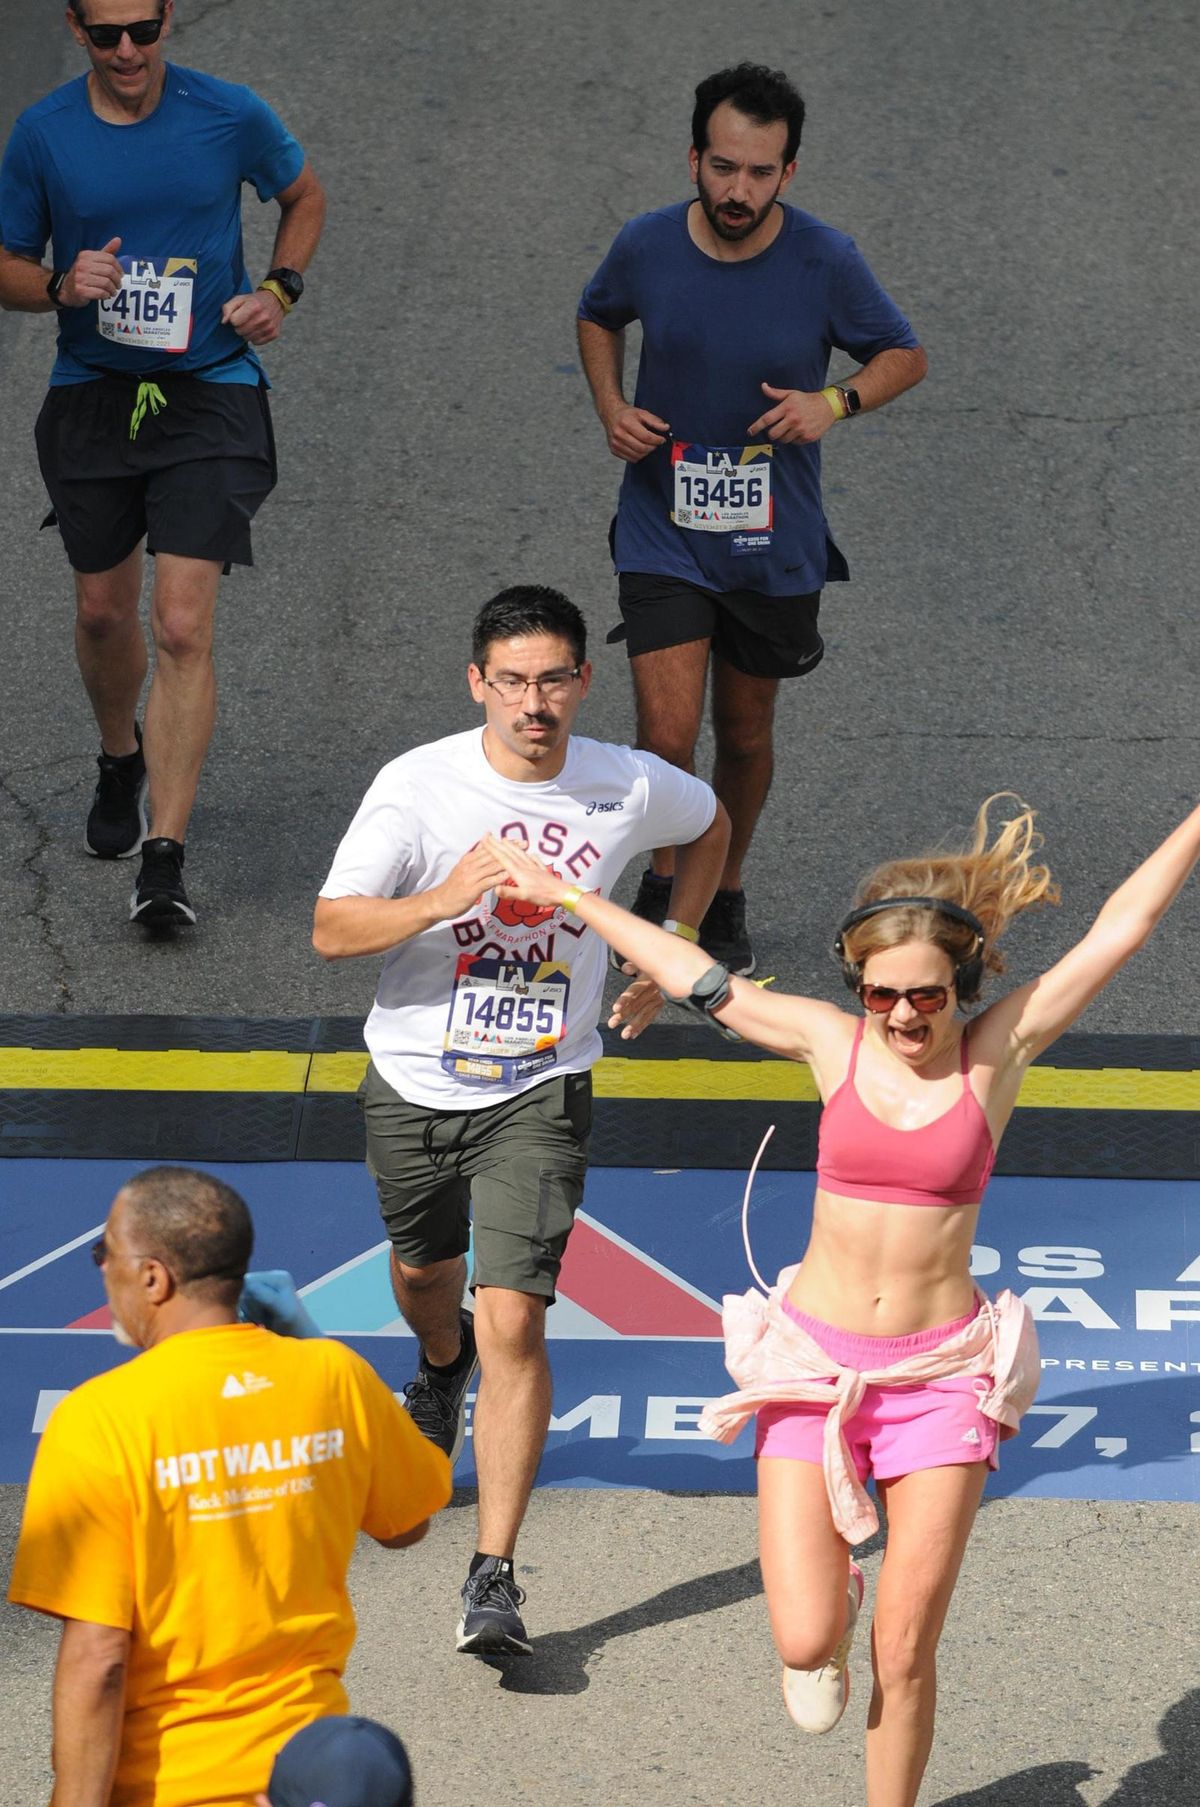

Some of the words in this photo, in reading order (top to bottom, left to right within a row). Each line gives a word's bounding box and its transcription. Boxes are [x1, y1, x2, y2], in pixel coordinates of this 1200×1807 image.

[680, 476, 762, 508] 13456
[597, 801, 624, 813] asics
[499, 821, 601, 880] OSE
[494, 928, 546, 945] MARATHON
[463, 992, 555, 1034] 14855
[155, 1449, 219, 1490] HOT
[223, 1428, 345, 1477] WALKER
[275, 1480, 289, 1497] of
[290, 1475, 315, 1495] USC
